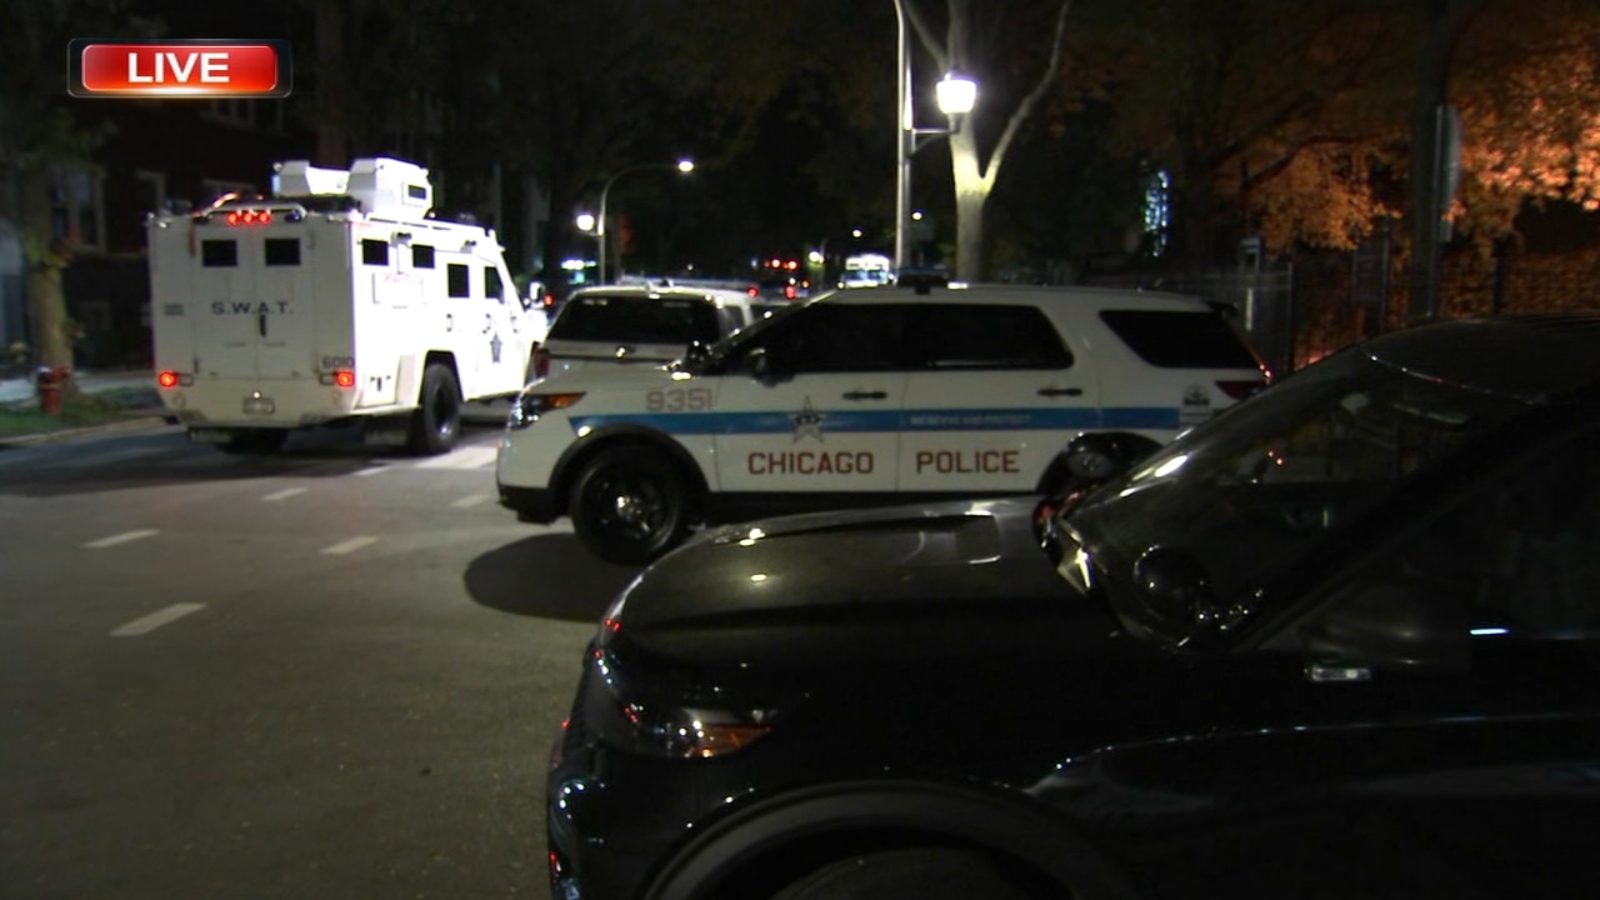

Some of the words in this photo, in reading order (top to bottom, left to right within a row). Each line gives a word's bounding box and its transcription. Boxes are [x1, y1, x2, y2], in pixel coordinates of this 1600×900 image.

[646, 388, 713, 411] 9351
[748, 452, 874, 474] CHICAGO
[916, 451, 1020, 473] POLICE
